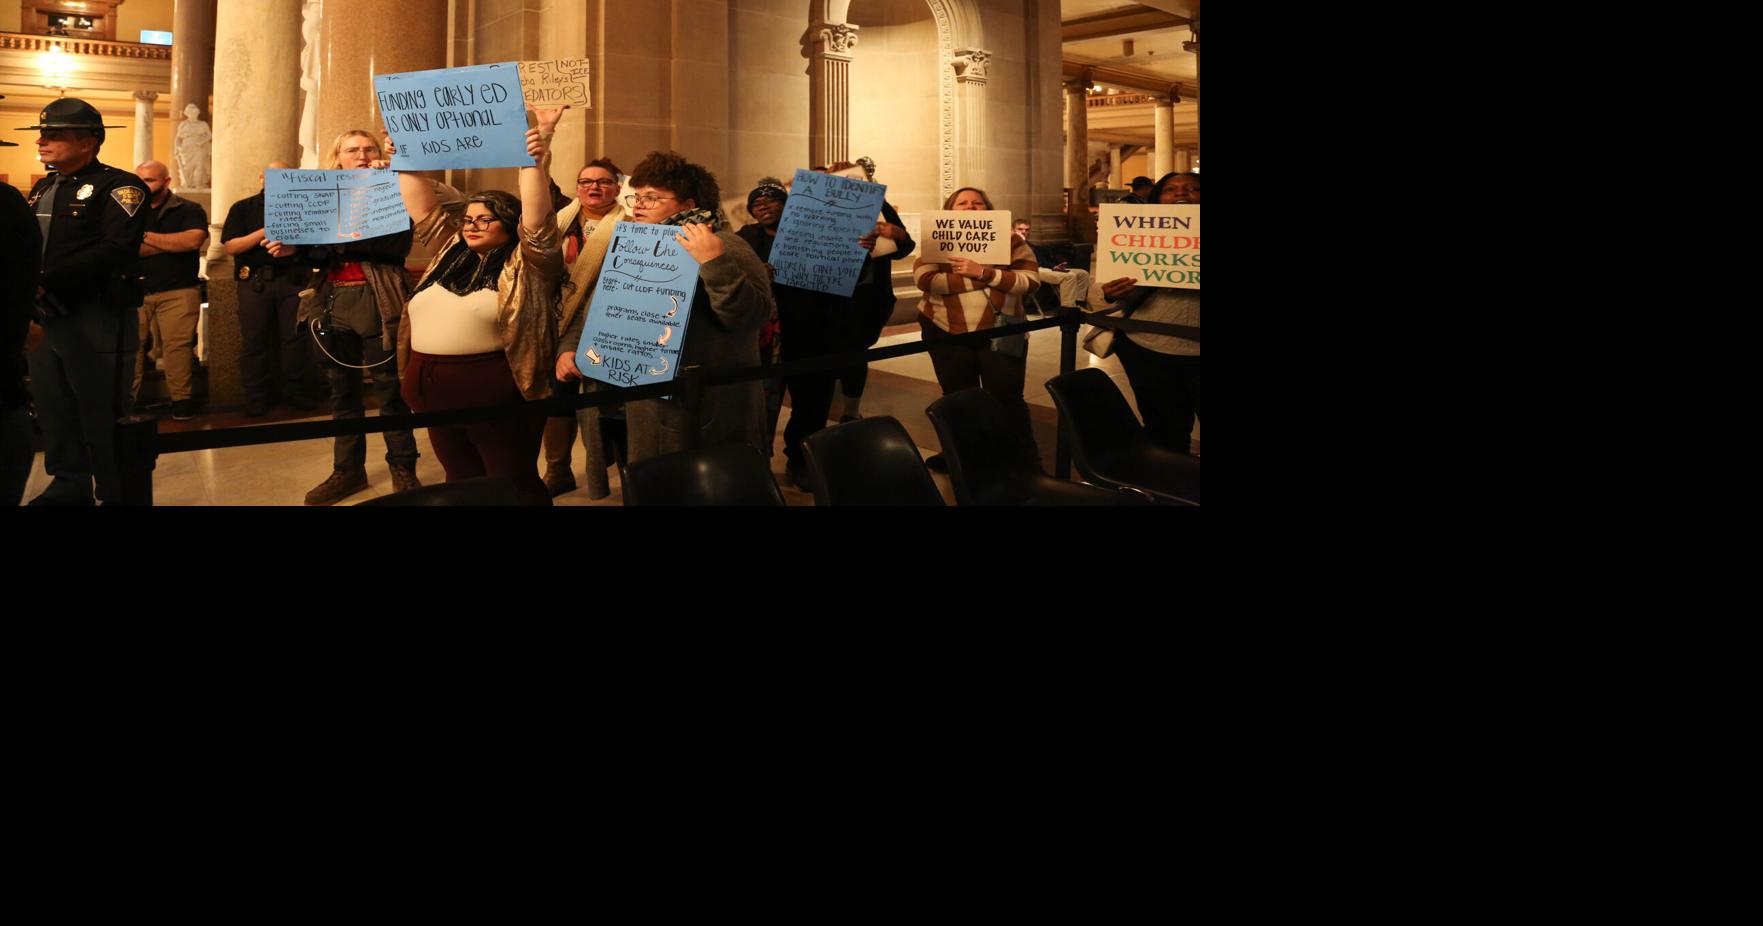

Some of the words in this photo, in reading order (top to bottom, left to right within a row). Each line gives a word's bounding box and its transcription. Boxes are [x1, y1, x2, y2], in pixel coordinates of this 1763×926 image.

[386, 117, 400, 133] IS
[400, 113, 430, 133] ONLY
[400, 144, 409, 155] IF
[421, 140, 451, 155] KIDS
[824, 189, 861, 203] BULLY
[936, 219, 955, 229] WE
[958, 219, 993, 229] VALUE
[1113, 216, 1192, 229] WHEN
[652, 227, 659, 235] to
[932, 230, 962, 240] CHILD
[966, 231, 996, 241] CARE
[940, 242, 954, 252] DO
[958, 242, 988, 253] YOU?
[774, 259, 806, 273] HILDREN
[602, 355, 631, 371] KIDS
[634, 363, 652, 375] AT
[608, 369, 639, 385] RISK
